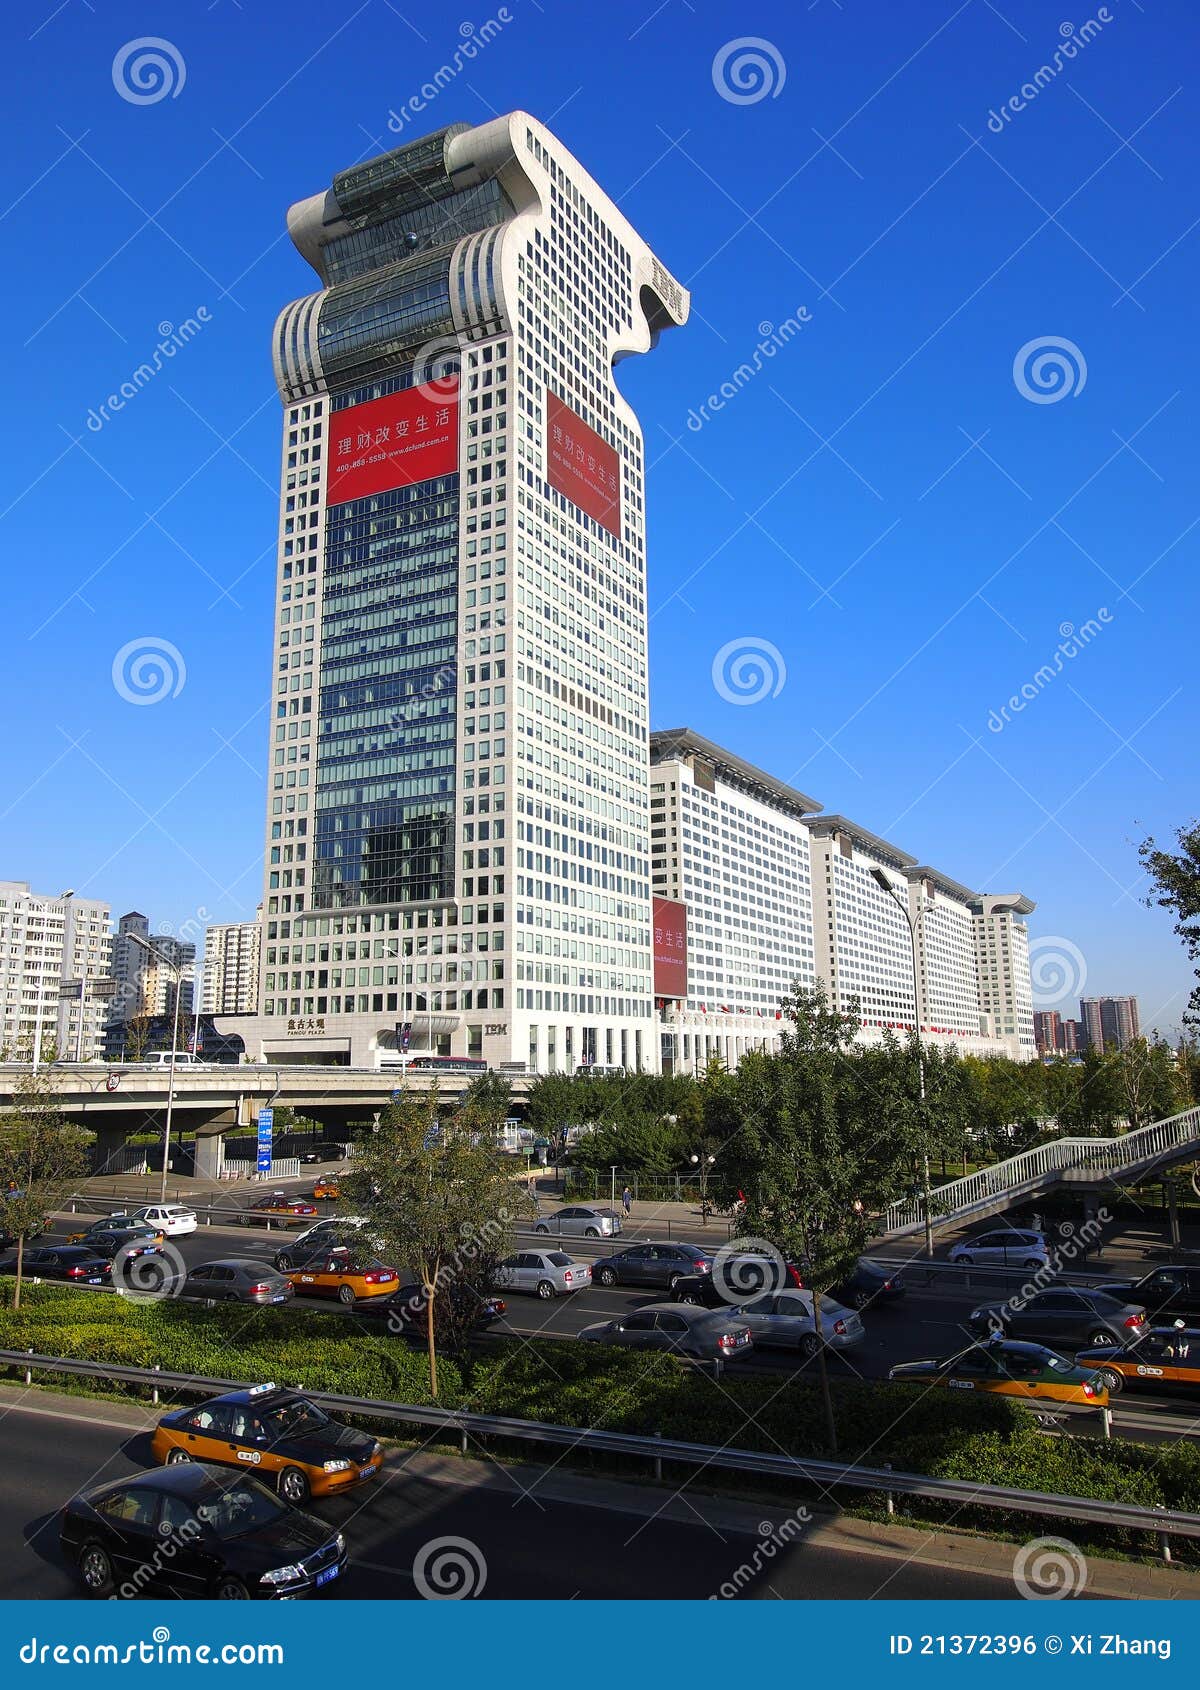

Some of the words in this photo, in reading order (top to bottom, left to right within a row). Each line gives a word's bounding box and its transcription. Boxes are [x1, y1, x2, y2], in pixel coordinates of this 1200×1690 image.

[337, 408, 450, 455] 理财改变生活
[485, 1023, 508, 1036] IBM
